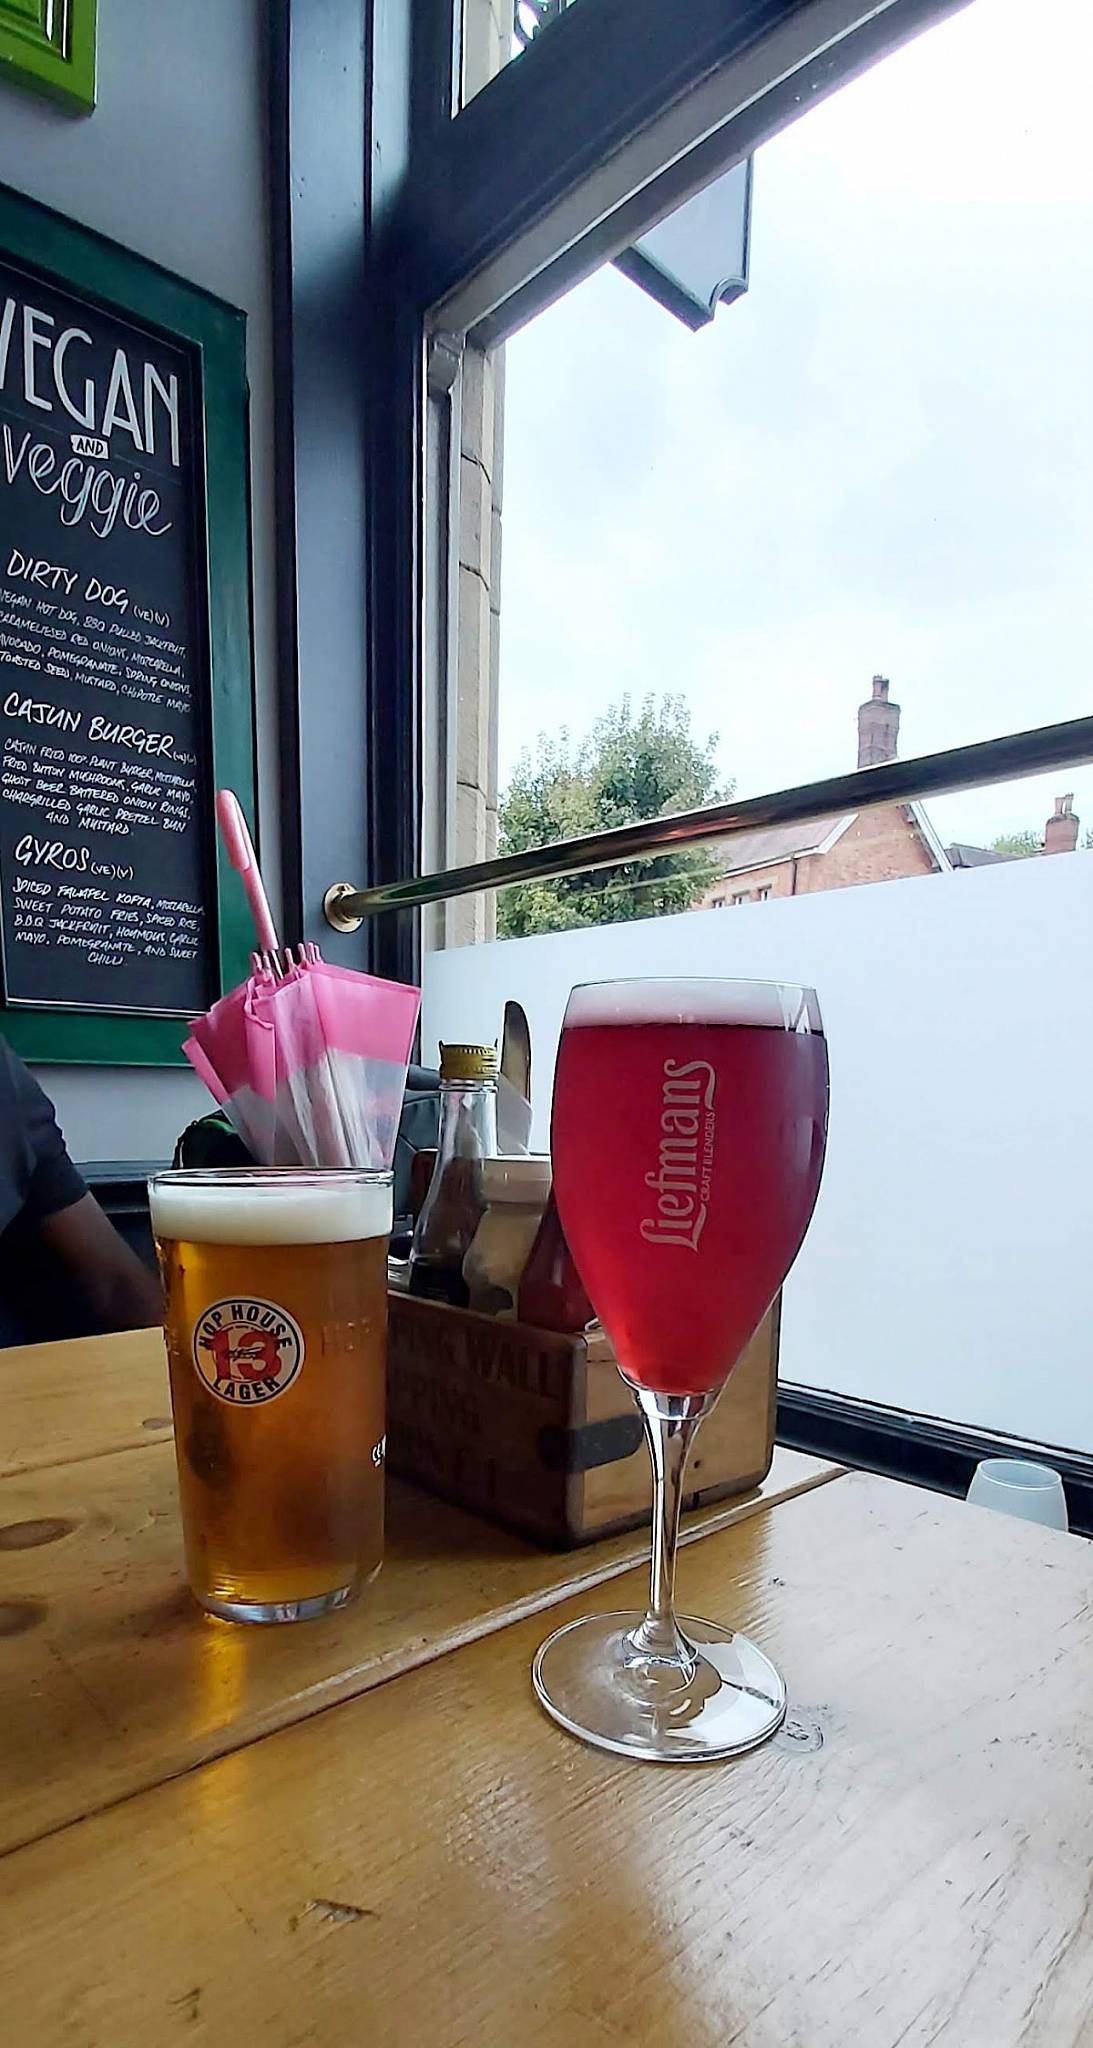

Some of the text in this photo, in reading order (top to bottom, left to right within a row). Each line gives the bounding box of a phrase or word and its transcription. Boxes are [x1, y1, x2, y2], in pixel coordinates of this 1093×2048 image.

[76, 438, 106, 458] AND
[7, 549, 78, 594] DIRTY
[85, 578, 129, 614] DOG
[36, 601, 59, 616] HOT
[83, 615, 106, 631] BBQ
[70, 633, 89, 646] RED
[3, 692, 81, 732] CAJUN
[88, 716, 174, 758] BURGER
[4, 738, 37, 756] CAJUN
[40, 746, 65, 761] FRIED
[89, 756, 118, 771] PLANT
[1, 772, 32, 787] GHOST
[35, 779, 67, 794] BEER
[69, 785, 120, 804] BATTERED
[123, 796, 157, 810] ONION
[2, 755, 28, 772] FRIED
[32, 761, 66, 777] BUTTON
[131, 781, 162, 797] GARLIC
[2, 788, 187, 833] CHARGRILLED GARLIC PRETZEL BUN
[45, 811, 70, 825] AND
[15, 835, 90, 871] GYROS
[12, 877, 52, 896] SPICED
[57, 885, 111, 902] FALAFEL
[13, 897, 54, 914] SWEET
[60, 904, 103, 919] POTATO
[145, 912, 176, 927] SPICED
[144, 944, 166, 957] AND
[169, 946, 198, 959] SWEET
[640, 1059, 716, 1252] Liefmans
[701, 1112, 716, 1202] CRAFT BLENDERS
[198, 1311, 225, 1350] HOP
[231, 1304, 293, 1350] HOUSE
[211, 1329, 283, 1383] 13
[213, 1375, 281, 1401] LAGER
